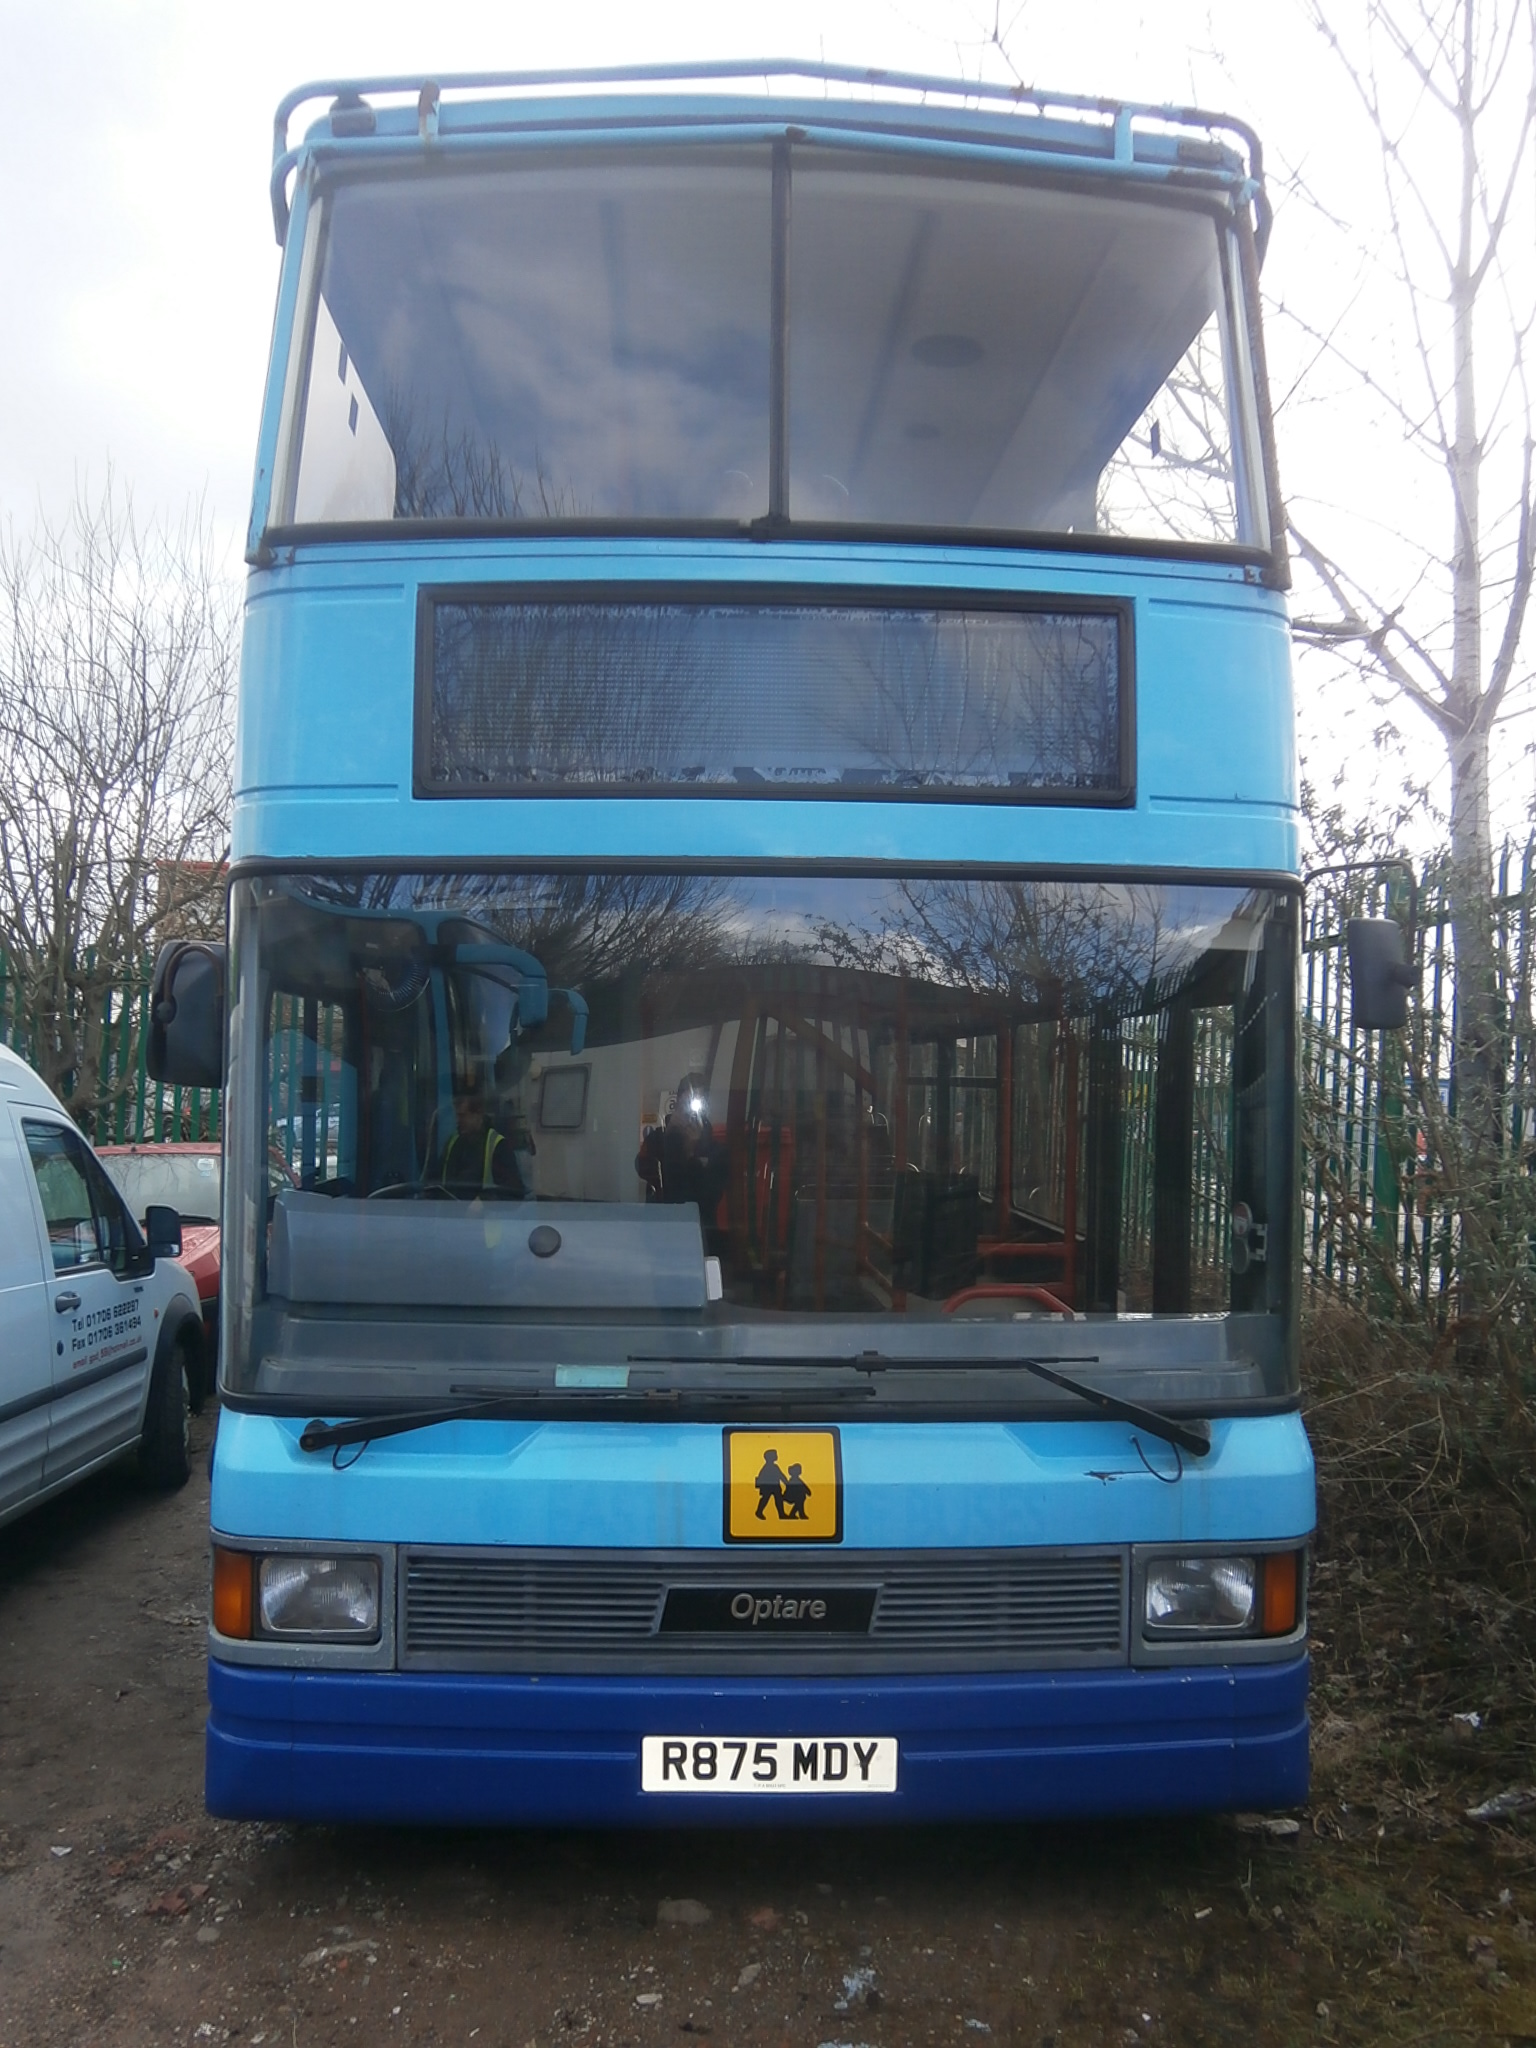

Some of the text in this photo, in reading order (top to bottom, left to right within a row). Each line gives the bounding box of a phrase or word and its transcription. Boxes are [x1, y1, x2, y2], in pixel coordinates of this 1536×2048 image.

[72, 1318, 84, 1332] Tel
[72, 1338, 86, 1351] Fax
[731, 1593, 827, 1625] Optare
[662, 1742, 878, 1781] R875 MDY
